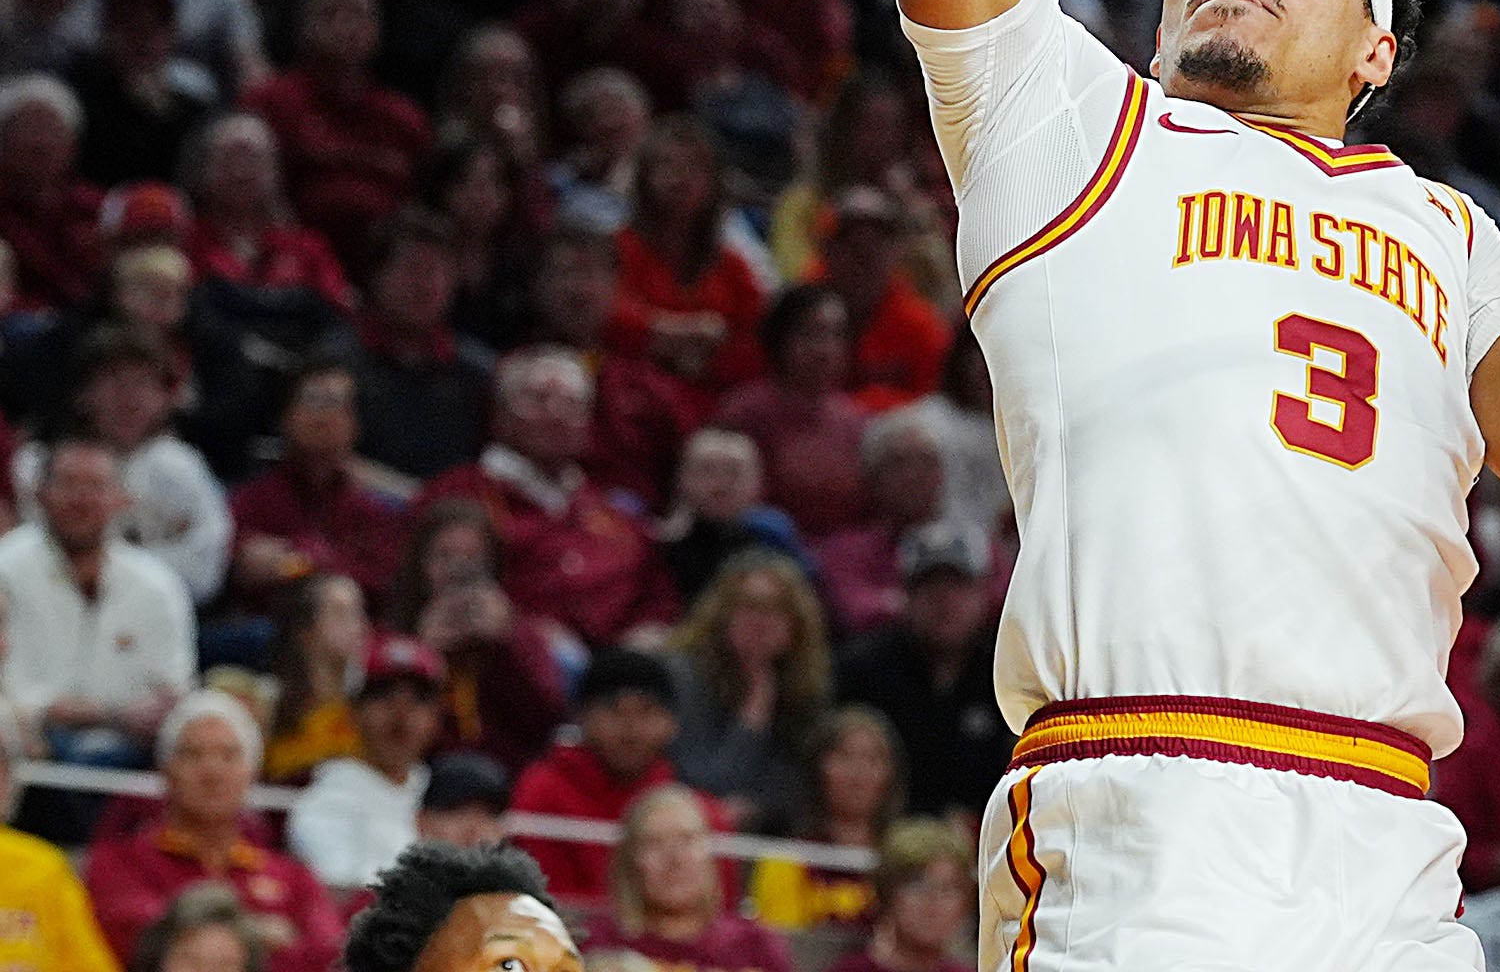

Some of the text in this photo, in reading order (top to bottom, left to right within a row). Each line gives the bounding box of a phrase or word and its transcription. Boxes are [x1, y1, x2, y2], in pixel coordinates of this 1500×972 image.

[1172, 189, 1449, 369] IOWA STATE
[1269, 311, 1380, 471] 3
